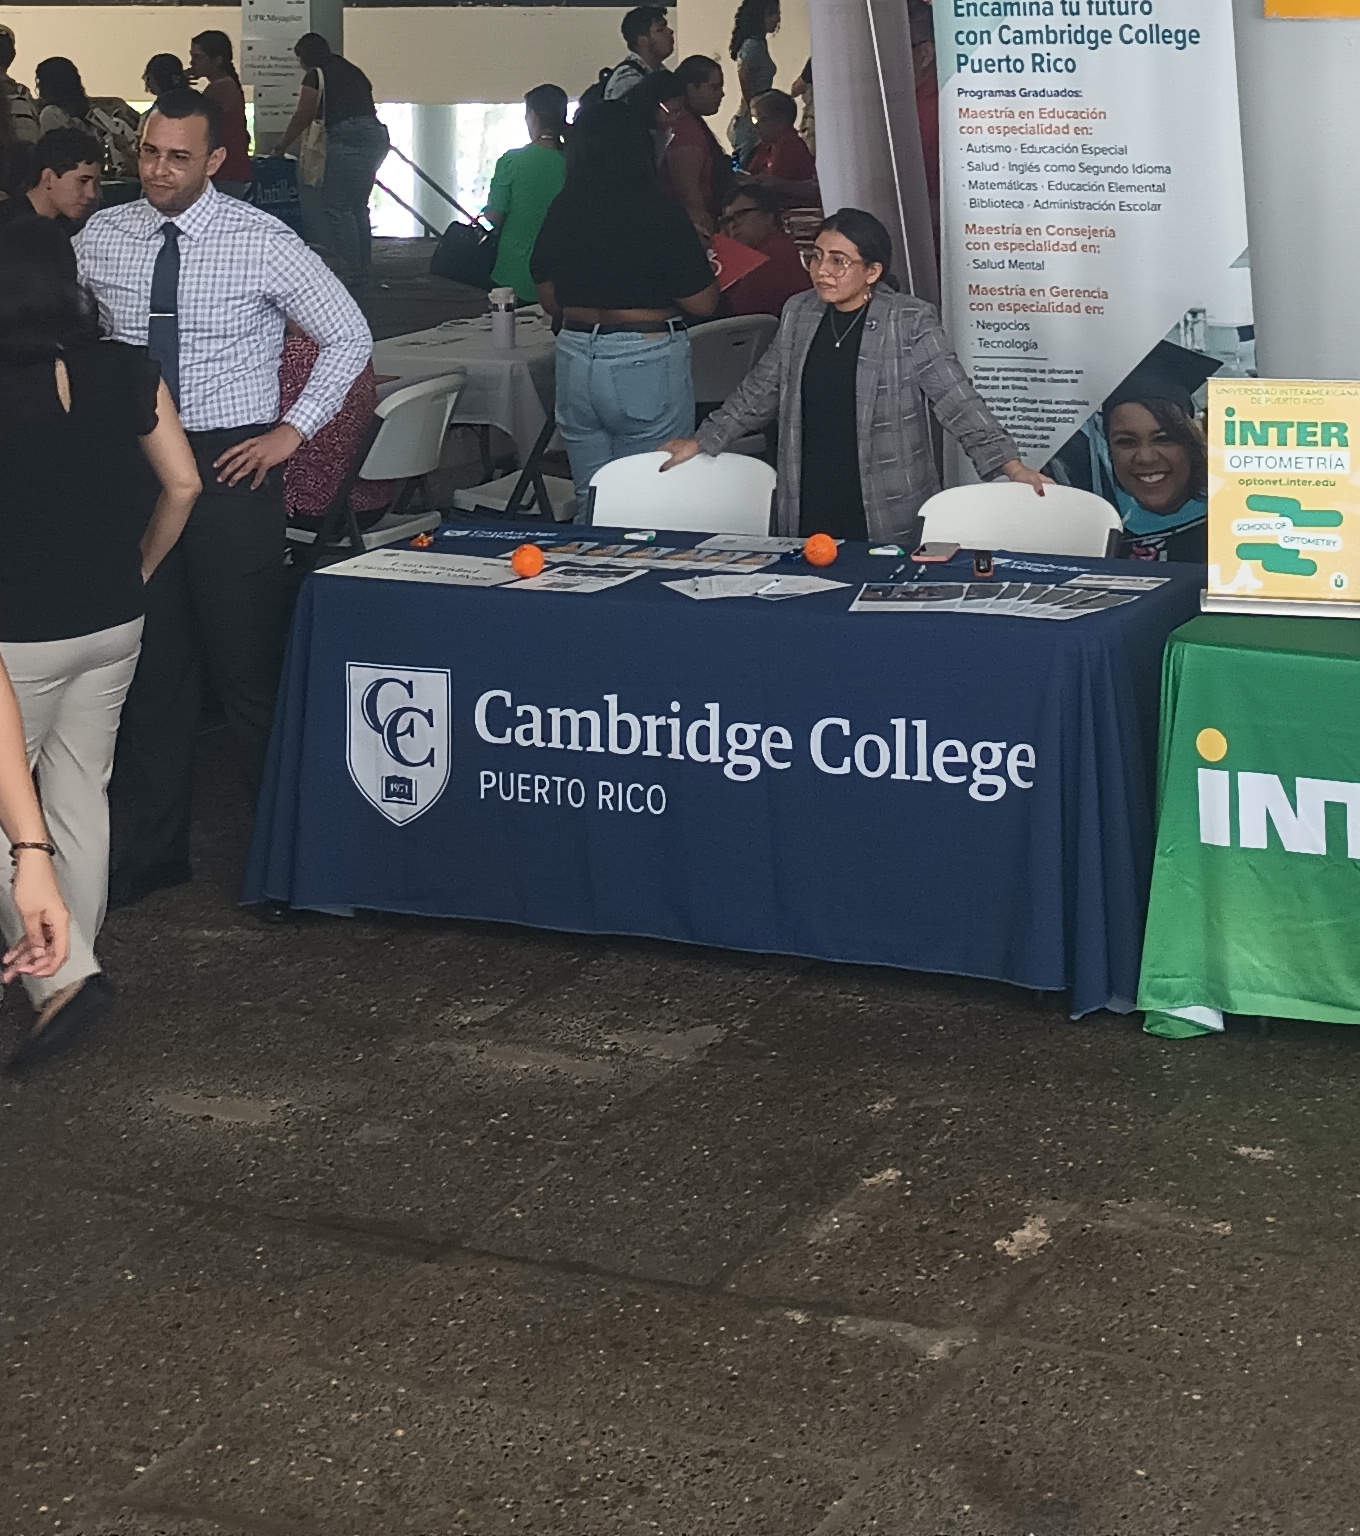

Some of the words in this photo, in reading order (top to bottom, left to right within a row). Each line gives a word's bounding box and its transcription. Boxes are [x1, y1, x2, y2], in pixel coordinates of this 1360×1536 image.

[954, 29, 992, 46] con
[998, 24, 1113, 50] Cambridge
[1119, 23, 1201, 50] College
[956, 54, 1025, 74] Puerto
[1032, 53, 1077, 74] Rico
[957, 88, 1016, 101] Programas
[1019, 88, 1083, 99] Graduados:
[959, 107, 1015, 120] Maestría
[1019, 110, 1034, 120] en
[1039, 107, 1107, 120] Educación
[959, 126, 983, 135] con
[987, 124, 1070, 137] especialidad
[1074, 125, 1093, 136] en:
[966, 143, 1011, 154] Autismo
[1020, 143, 1079, 155] Educación
[1081, 144, 1128, 157] Especial
[967, 161, 999, 172] Salud
[1008, 161, 1040, 175] Inglés
[1043, 164, 1075, 173] como
[1078, 163, 1129, 176] Segundo
[1132, 163, 1172, 175] Idioma
[968, 180, 1038, 191] Matemáticas
[1047, 180, 1105, 193] Educación
[1108, 182, 1166, 194] Elemental
[969, 198, 1024, 210] Biblioteca
[1033, 199, 1116, 212] Administración
[1118, 201, 1162, 212] Escolar
[965, 223, 1022, 236] Maestría
[1026, 226, 1042, 236] en
[1046, 225, 1116, 240] Consejería
[965, 241, 990, 251] con
[994, 240, 1077, 254] especialidad
[1081, 242, 1101, 254] en:
[972, 259, 1005, 270] Salud
[1008, 260, 1045, 271] Mental
[968, 284, 1026, 297] Maestría
[1030, 288, 1046, 298] en
[1050, 286, 1109, 300] Gerencia
[969, 302, 993, 312] con
[998, 301, 1081, 317] especialidad
[976, 320, 1030, 332] Negocios
[978, 339, 1038, 351] Tecnología
[1216, 388, 1277, 396] UNIVERSIDAD
[1279, 388, 1359, 397] INTERAMERICANA
[1250, 396, 1262, 404] DE
[1265, 397, 1300, 405] PUERTO
[1230, 454, 1345, 470] OPTOMETRÍA
[1238, 477, 1336, 489] optonet.inter.edu
[1237, 523, 1273, 531] SCHOOL
[1275, 522, 1286, 530] OF
[1283, 536, 1337, 547] OPTOMETRY
[475, 688, 792, 782] Cambridge
[809, 717, 1037, 802] College
[479, 770, 586, 809] PUERTO
[597, 783, 667, 816] RICO
